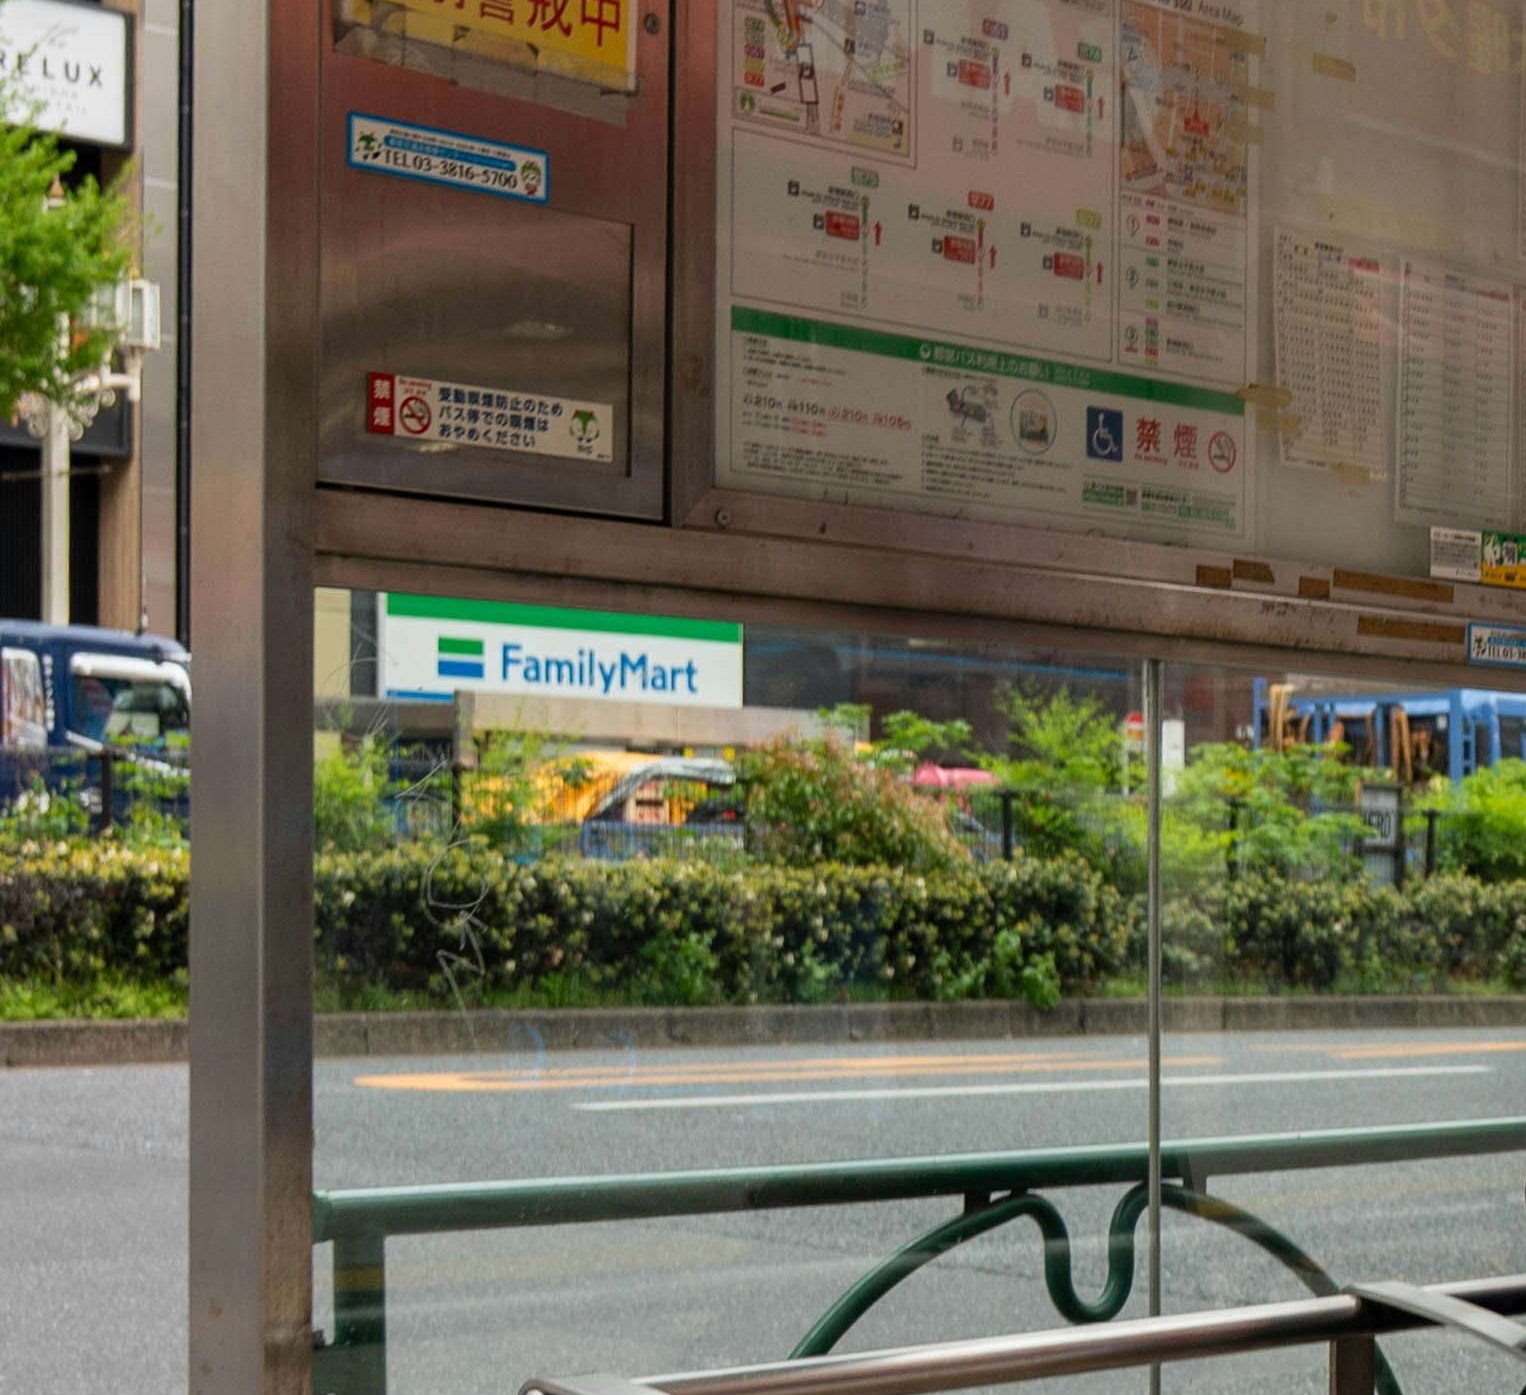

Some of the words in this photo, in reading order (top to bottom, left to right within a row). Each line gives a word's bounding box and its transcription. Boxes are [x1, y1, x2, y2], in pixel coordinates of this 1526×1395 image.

[384, 150, 411, 169] TEL
[413, 155, 518, 189] 03-3816-5700
[373, 378, 392, 427] 禁煙
[438, 405, 550, 433] バス停での喫煙は
[438, 422, 537, 448] おやめください
[1135, 414, 1200, 460] 禁煙
[503, 643, 698, 693] FamilyMart
